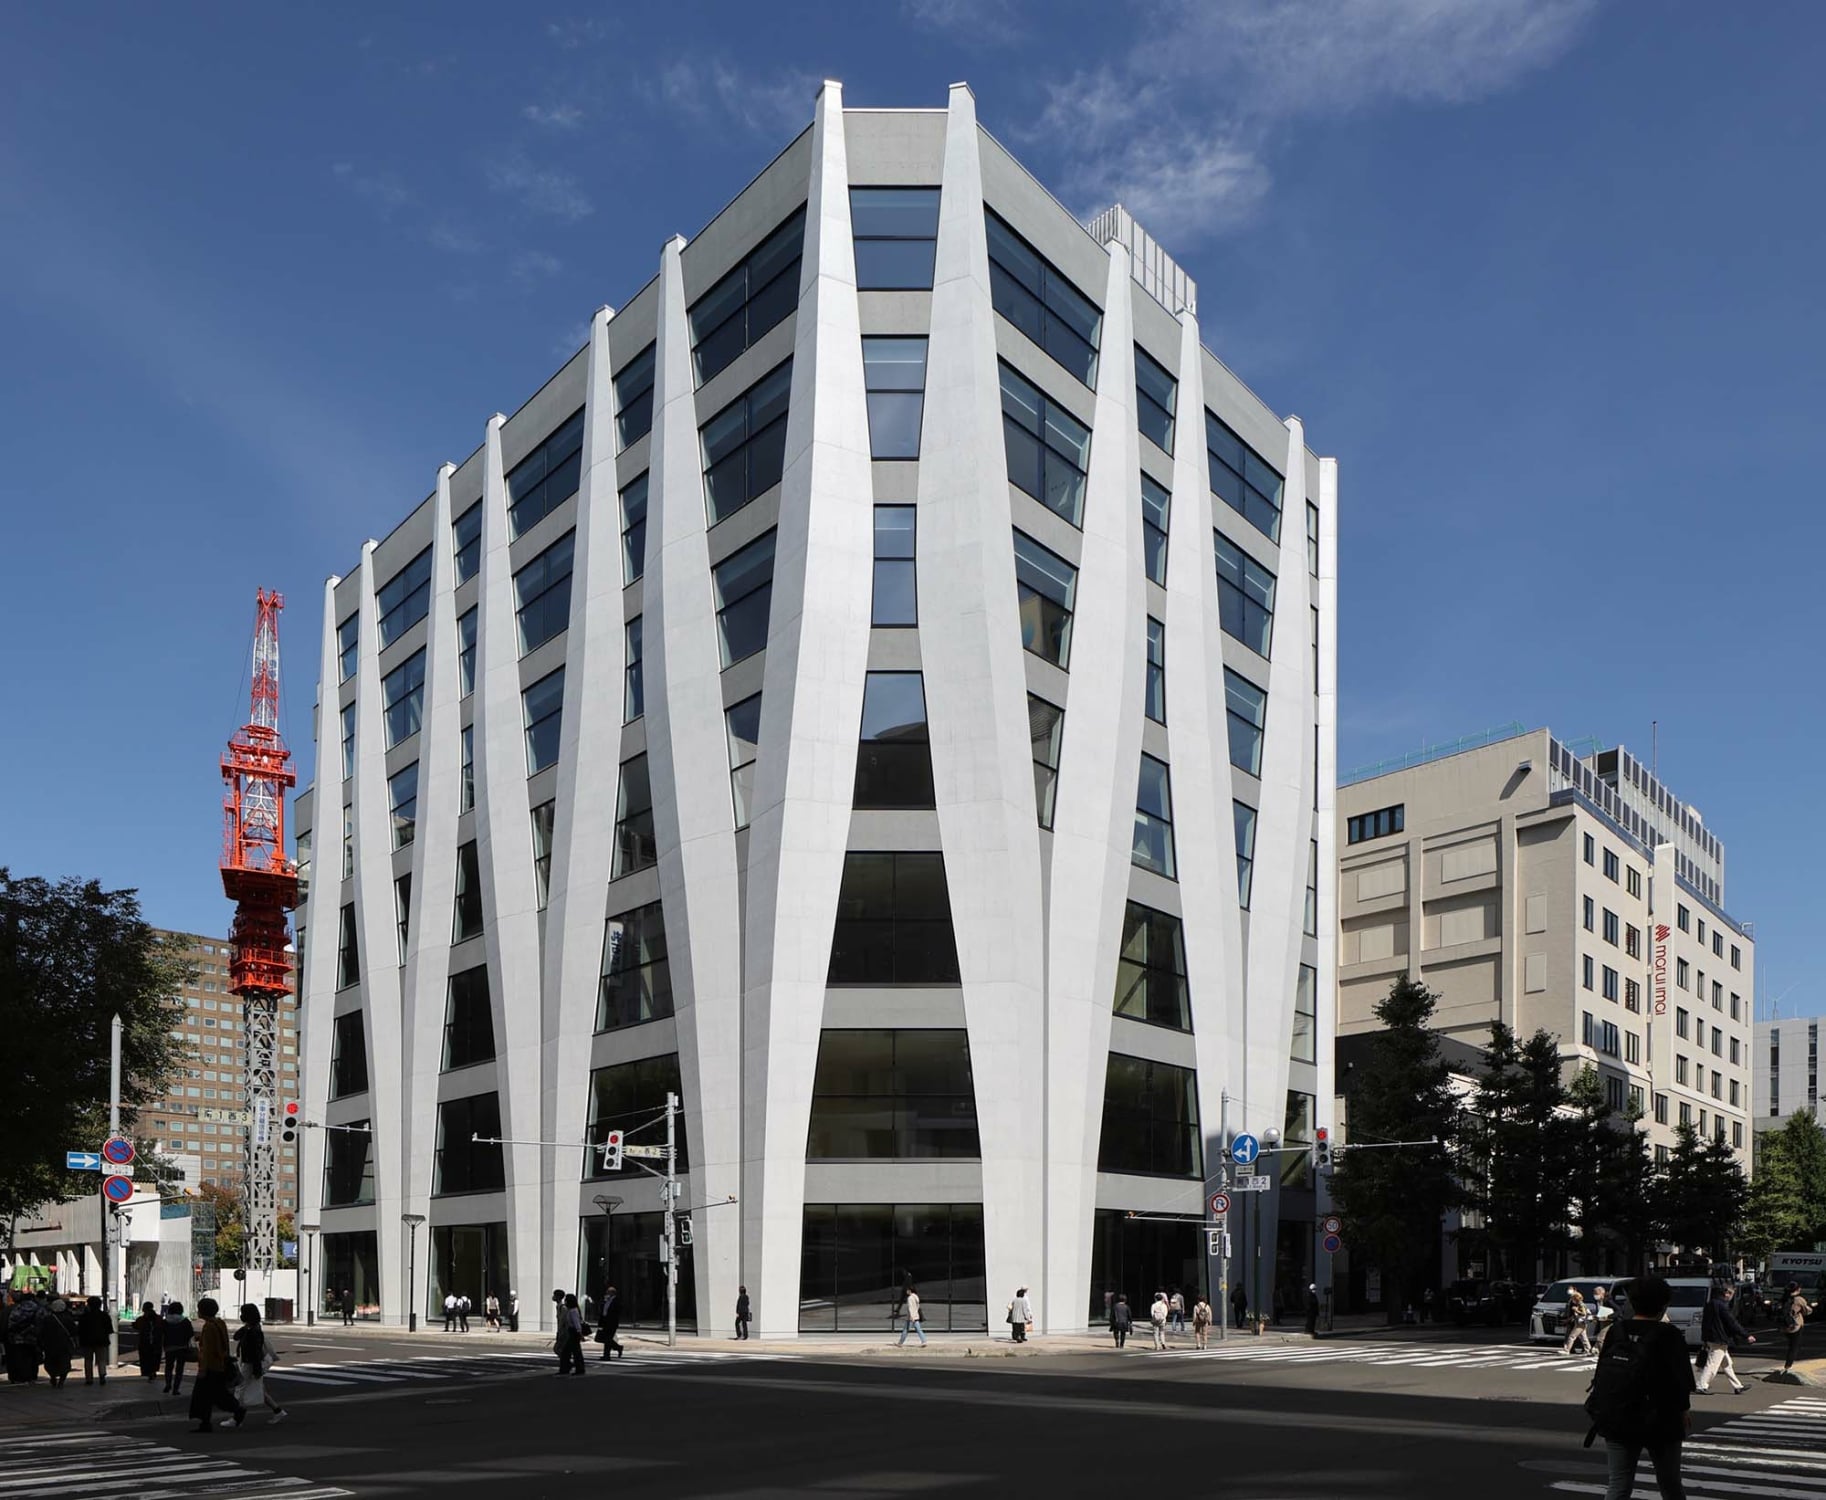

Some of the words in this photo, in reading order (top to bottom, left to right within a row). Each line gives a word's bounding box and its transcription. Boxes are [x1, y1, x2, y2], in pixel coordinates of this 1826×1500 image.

[1655, 945, 1667, 984] marui
[1655, 987, 1666, 1015] imai
[1328, 1221, 1338, 1230] 50
